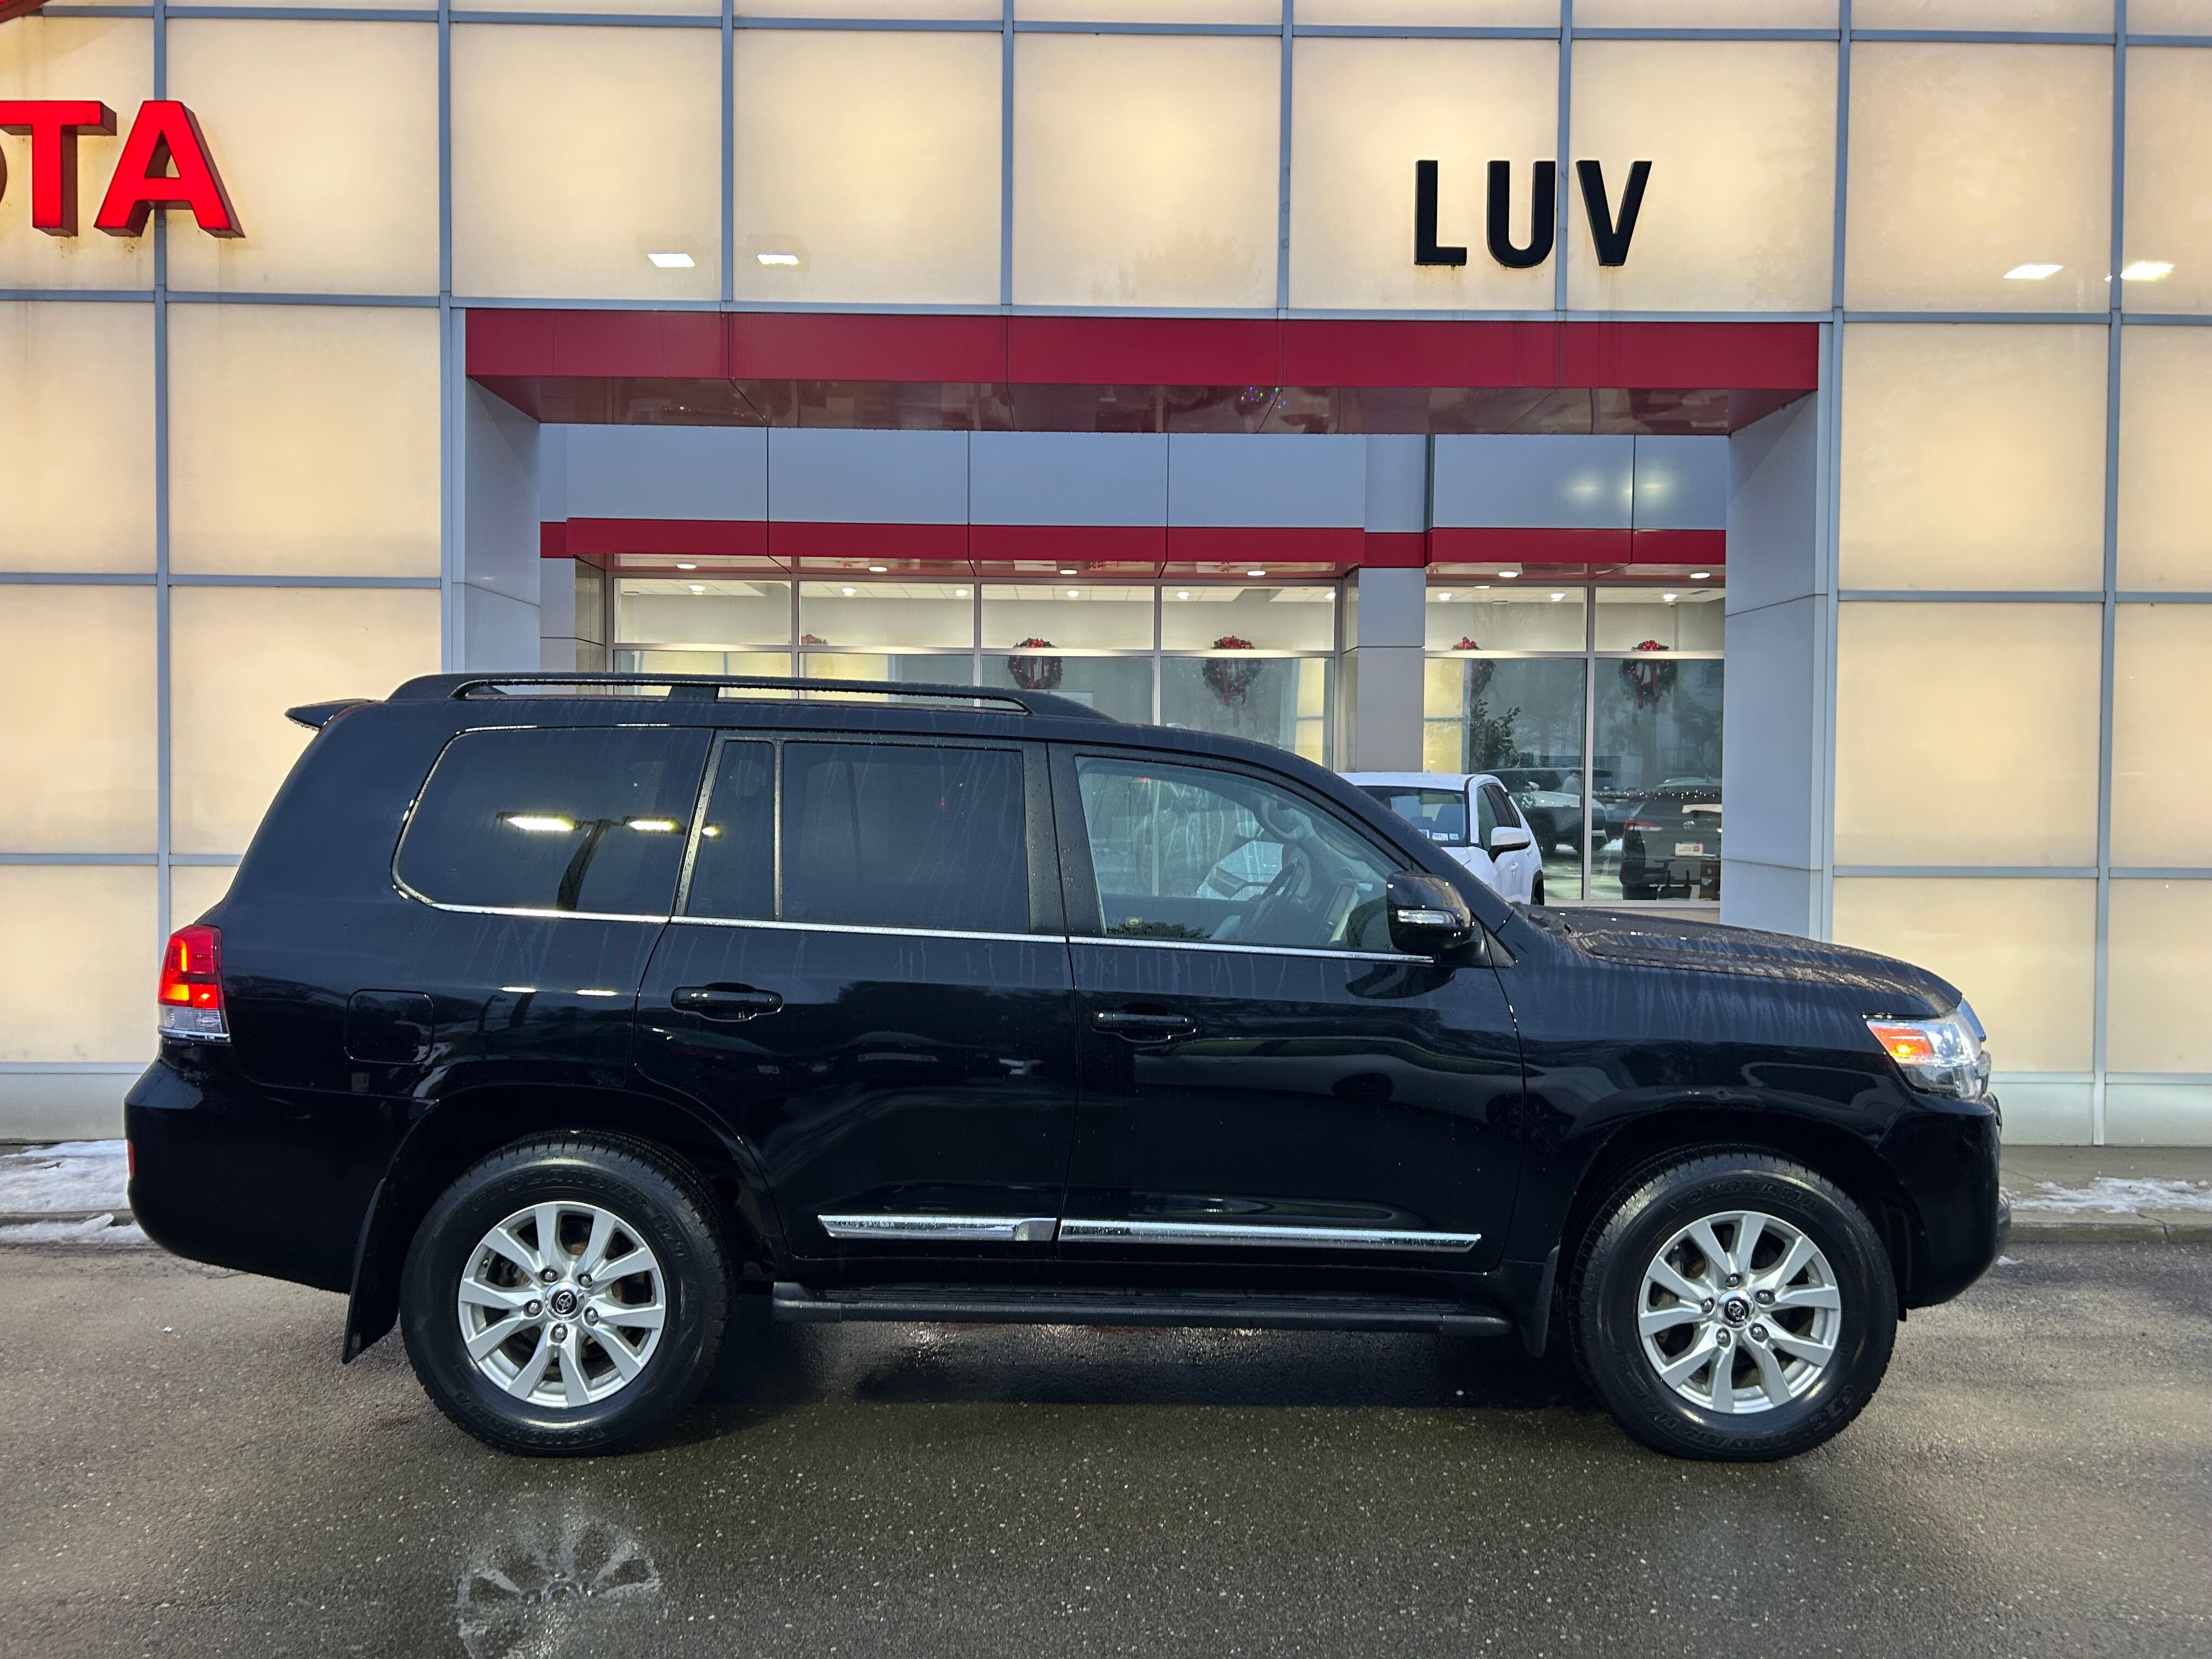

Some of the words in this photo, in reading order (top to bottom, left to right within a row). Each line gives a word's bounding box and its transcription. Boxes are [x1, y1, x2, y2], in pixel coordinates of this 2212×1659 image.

[0, 100, 246, 238] TA
[1414, 160, 1652, 268] LUV
[1668, 1180, 1819, 1212] YOKOHAMA
